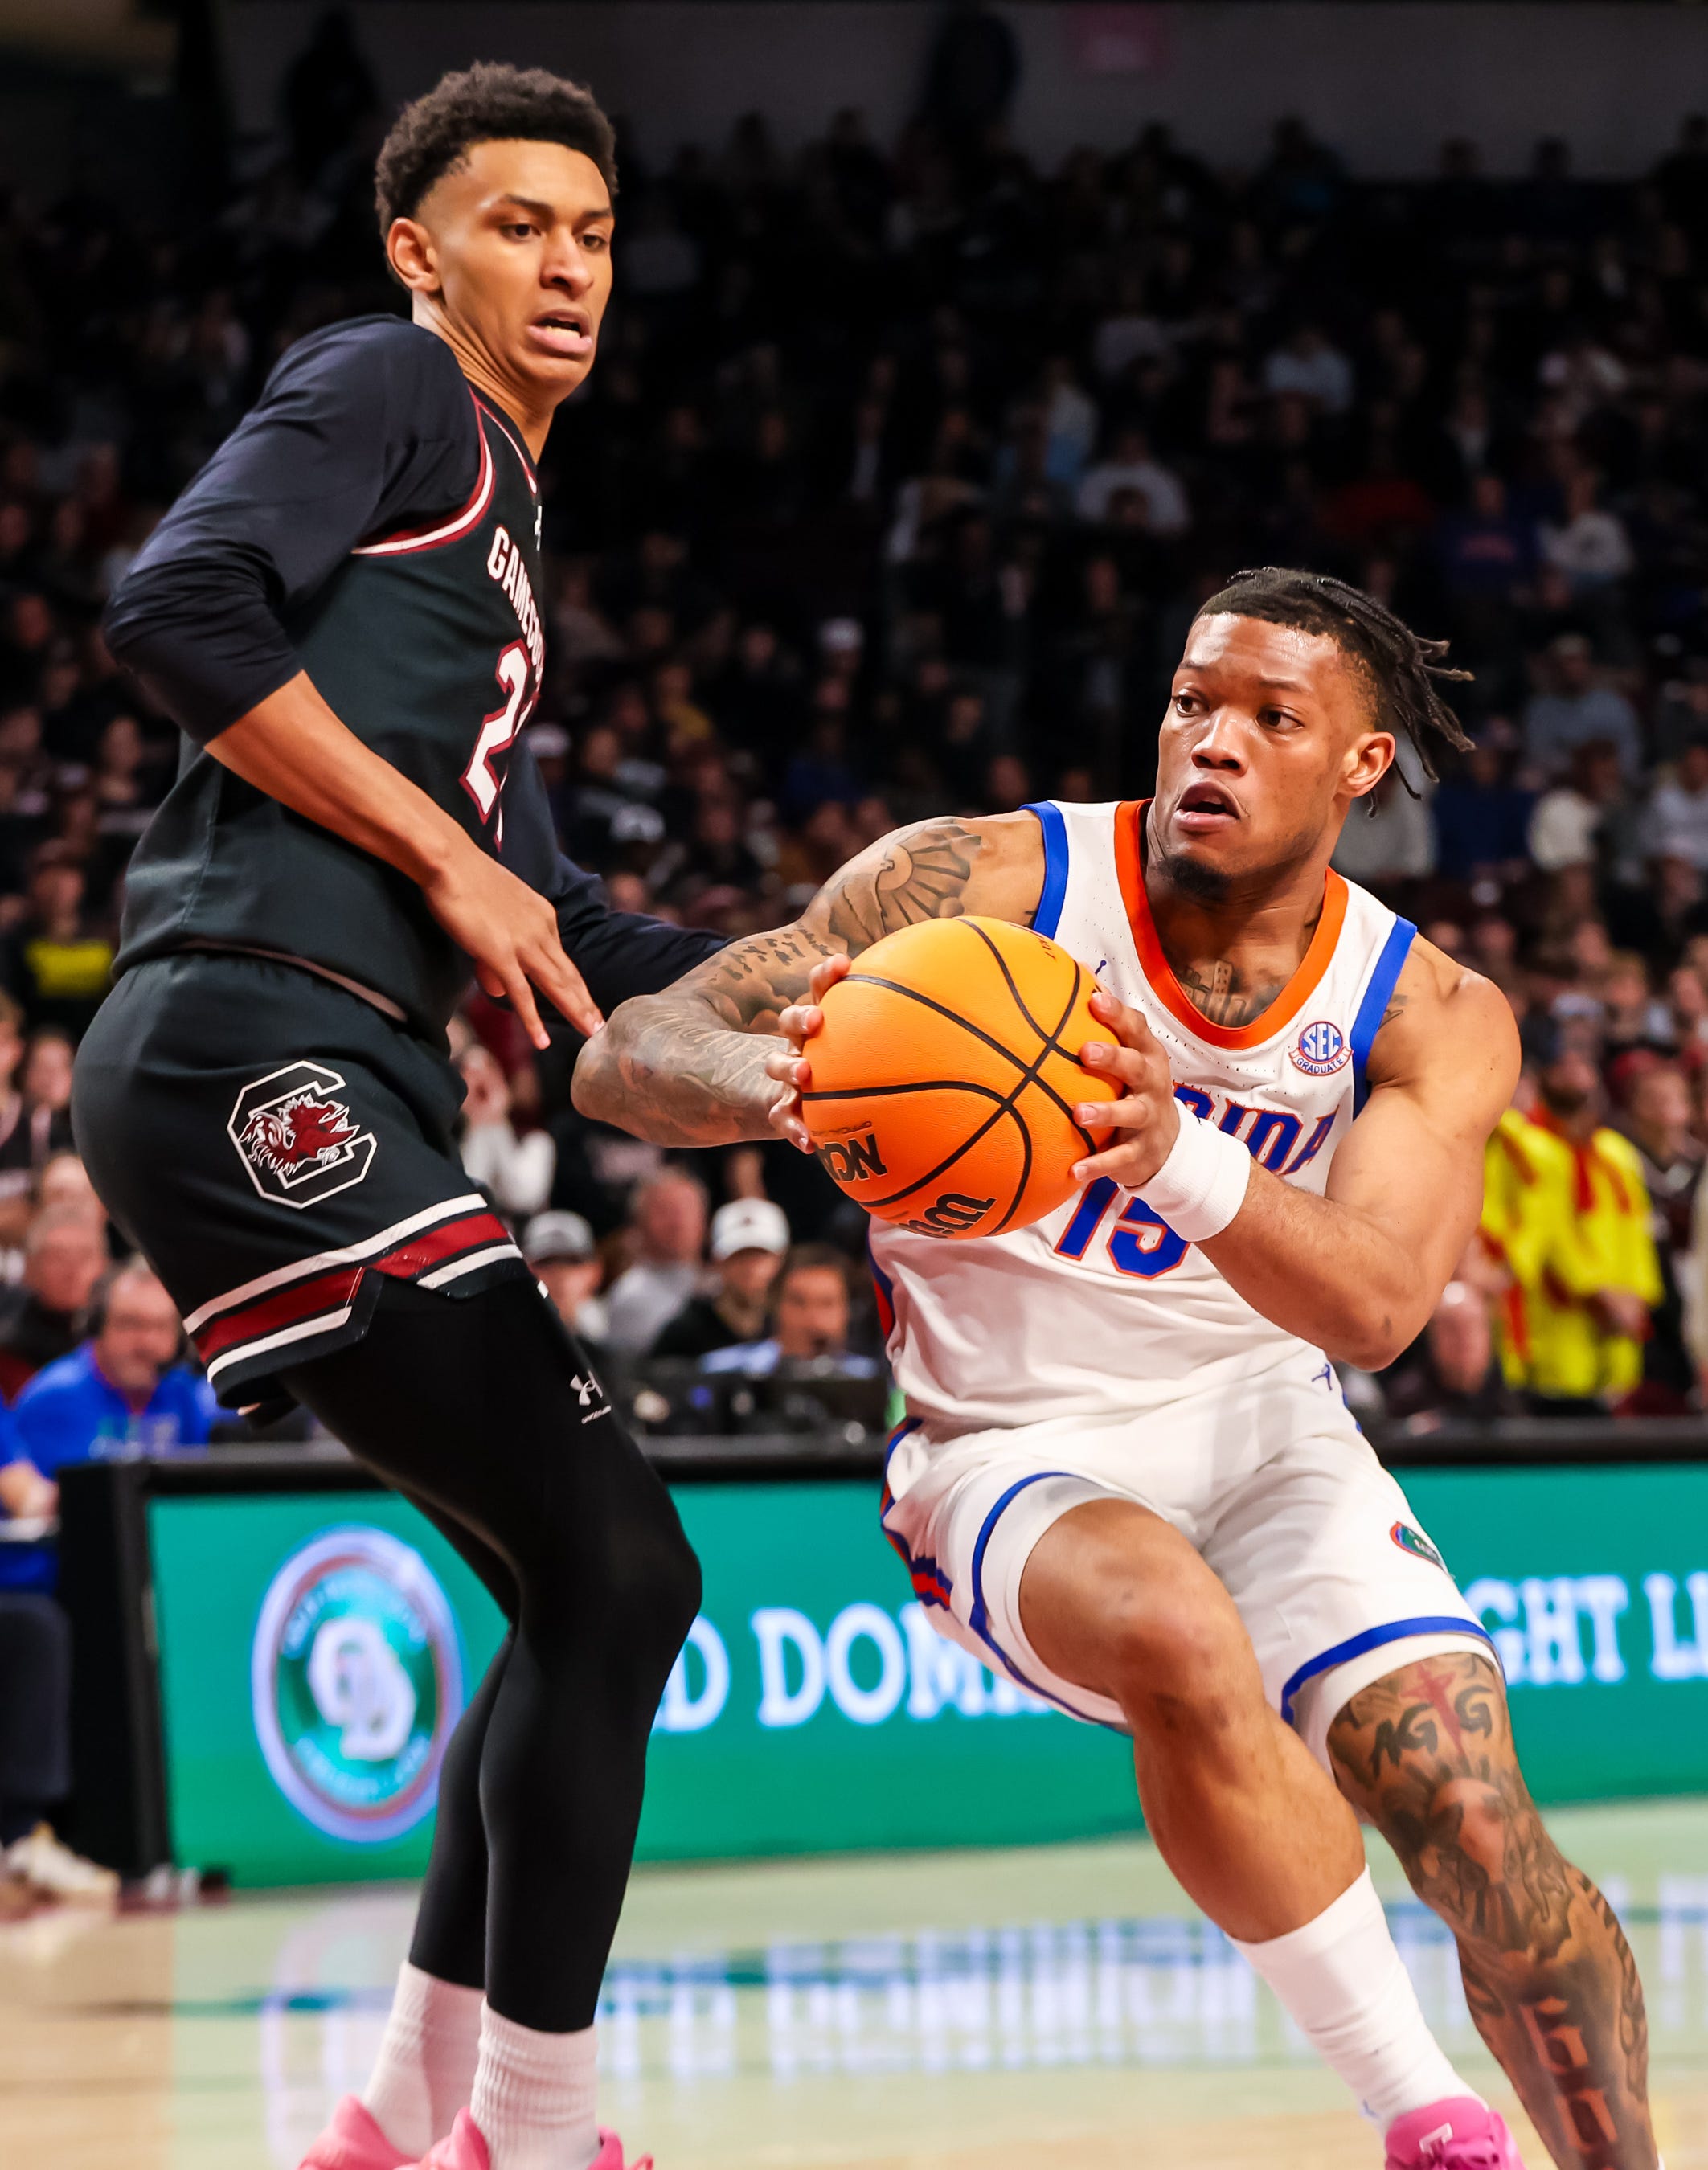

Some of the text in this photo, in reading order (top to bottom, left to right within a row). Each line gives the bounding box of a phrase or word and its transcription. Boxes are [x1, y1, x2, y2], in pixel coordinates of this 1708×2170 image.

[1302, 1023, 1341, 1060] SEC
[1296, 1057, 1344, 1074] GRADUATE
[1054, 1175, 1193, 1280] 15
